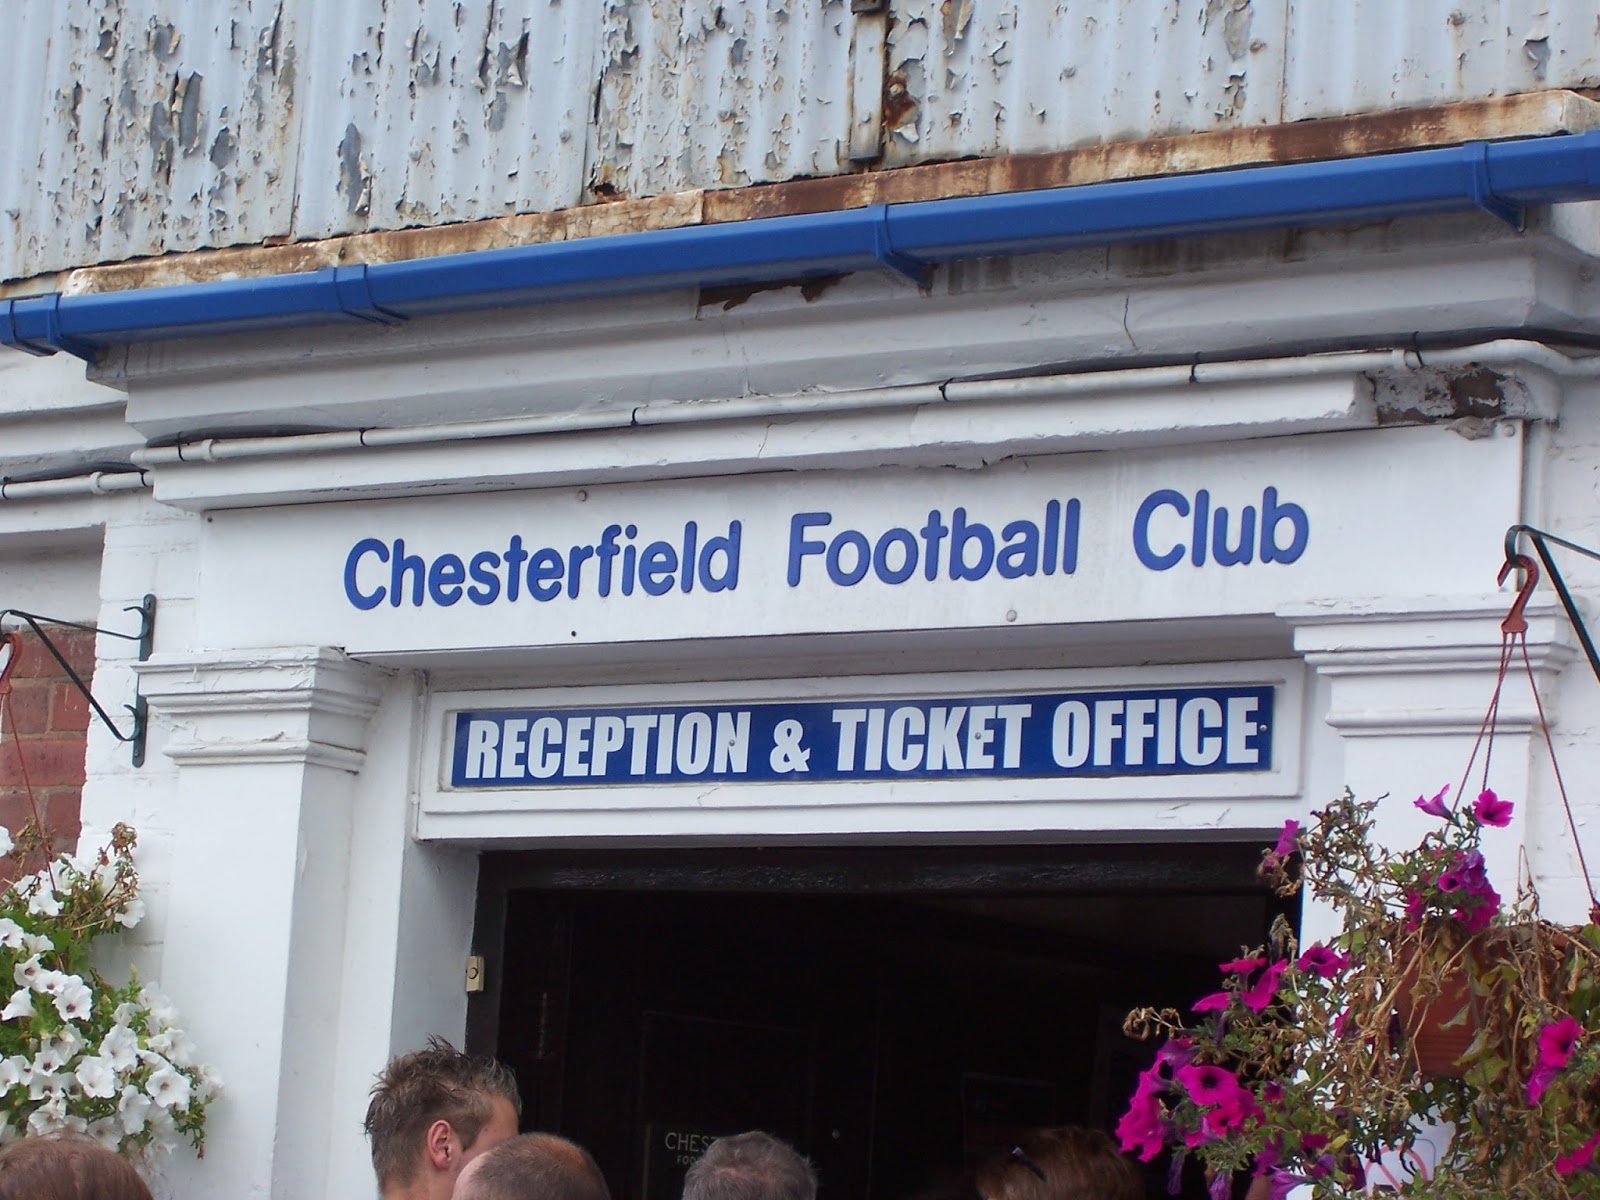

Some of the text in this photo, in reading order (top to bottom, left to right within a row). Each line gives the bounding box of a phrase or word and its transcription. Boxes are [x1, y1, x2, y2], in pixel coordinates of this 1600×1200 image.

[343, 486, 1310, 611] Chesterfield Football Club
[464, 696, 1259, 780] RECEPTION & TICKET OFFICE
